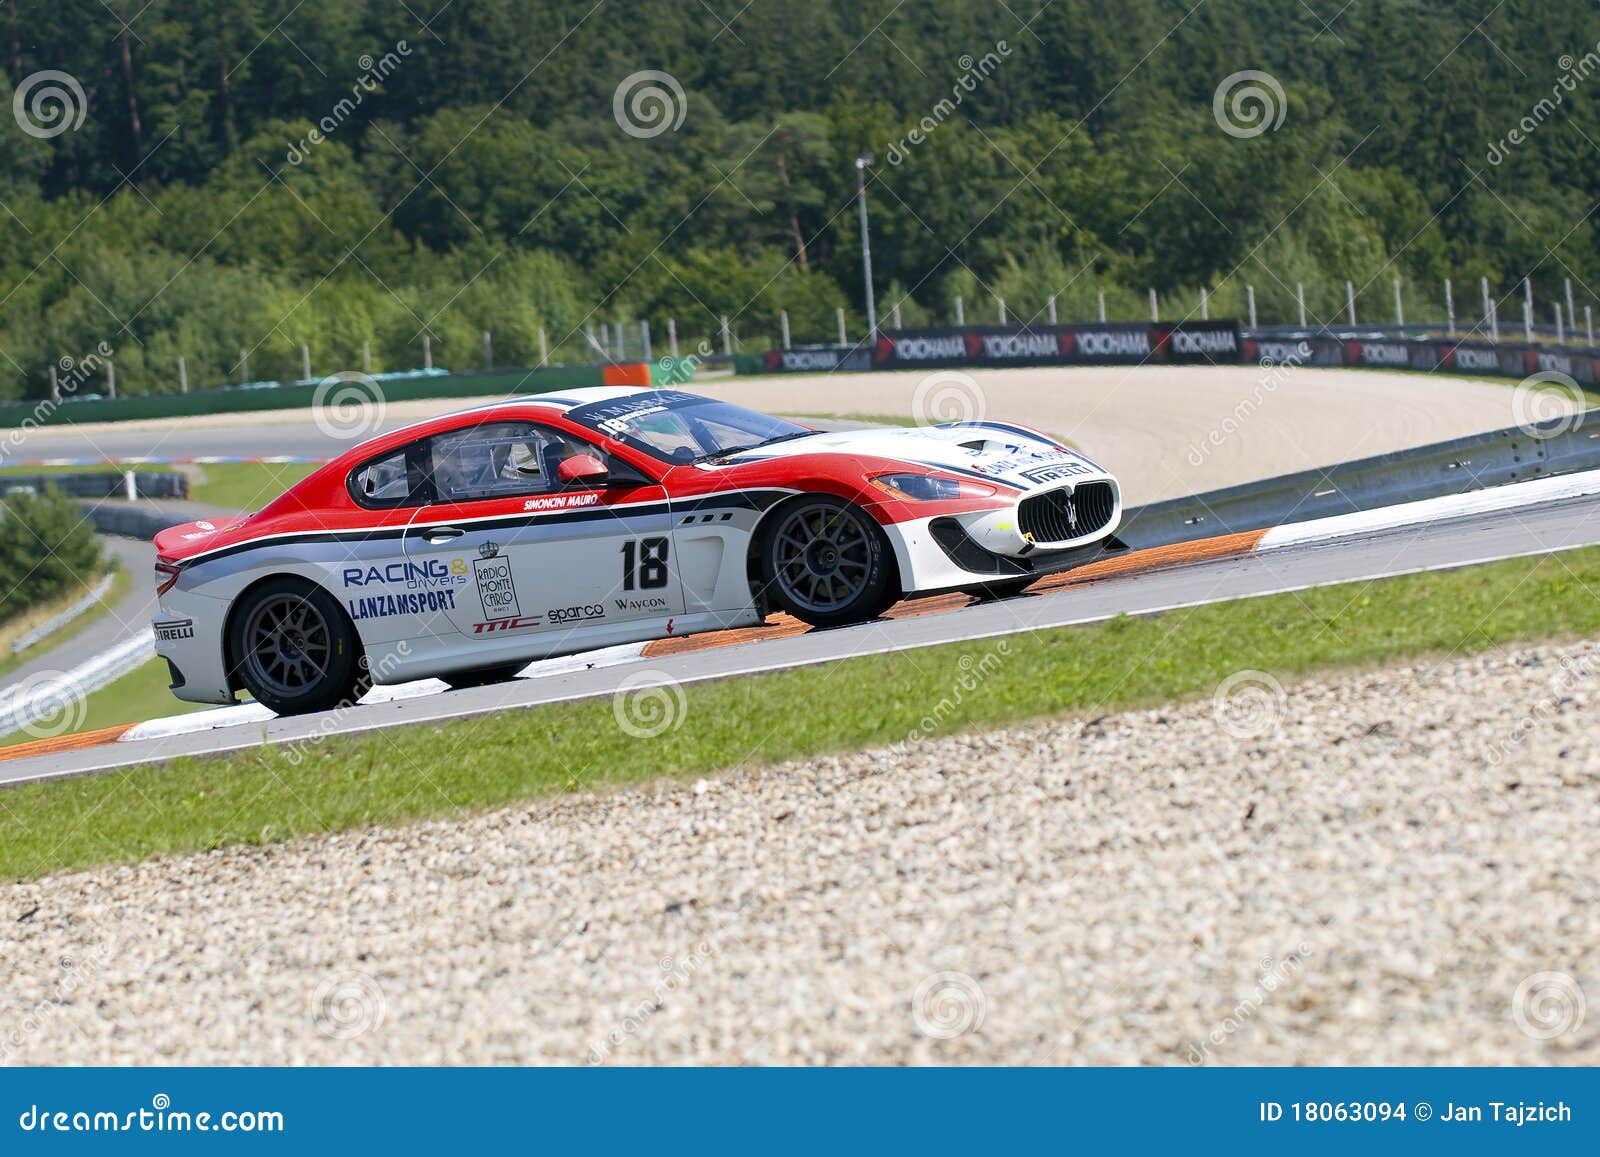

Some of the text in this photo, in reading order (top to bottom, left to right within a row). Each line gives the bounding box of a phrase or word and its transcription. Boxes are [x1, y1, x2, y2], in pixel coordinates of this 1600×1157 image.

[894, 337, 967, 359] YOKOHAMA
[984, 335, 1060, 357] YOKOHAMA
[1076, 332, 1149, 354] YOKOHAMA
[1171, 331, 1237, 353] YOKOHAMA
[597, 418, 630, 435] 18
[1018, 462, 1093, 484] PIRELLI
[524, 493, 598, 511] SIMONCINI MAURO
[343, 558, 468, 588] RACING &
[477, 566, 508, 581] RADIO
[620, 536, 669, 591] 18
[406, 575, 467, 590] drivers
[480, 578, 512, 593] MONTE
[349, 589, 456, 620] LANZAMSPORT
[484, 591, 513, 607] CARLO
[547, 604, 606, 624] sparco
